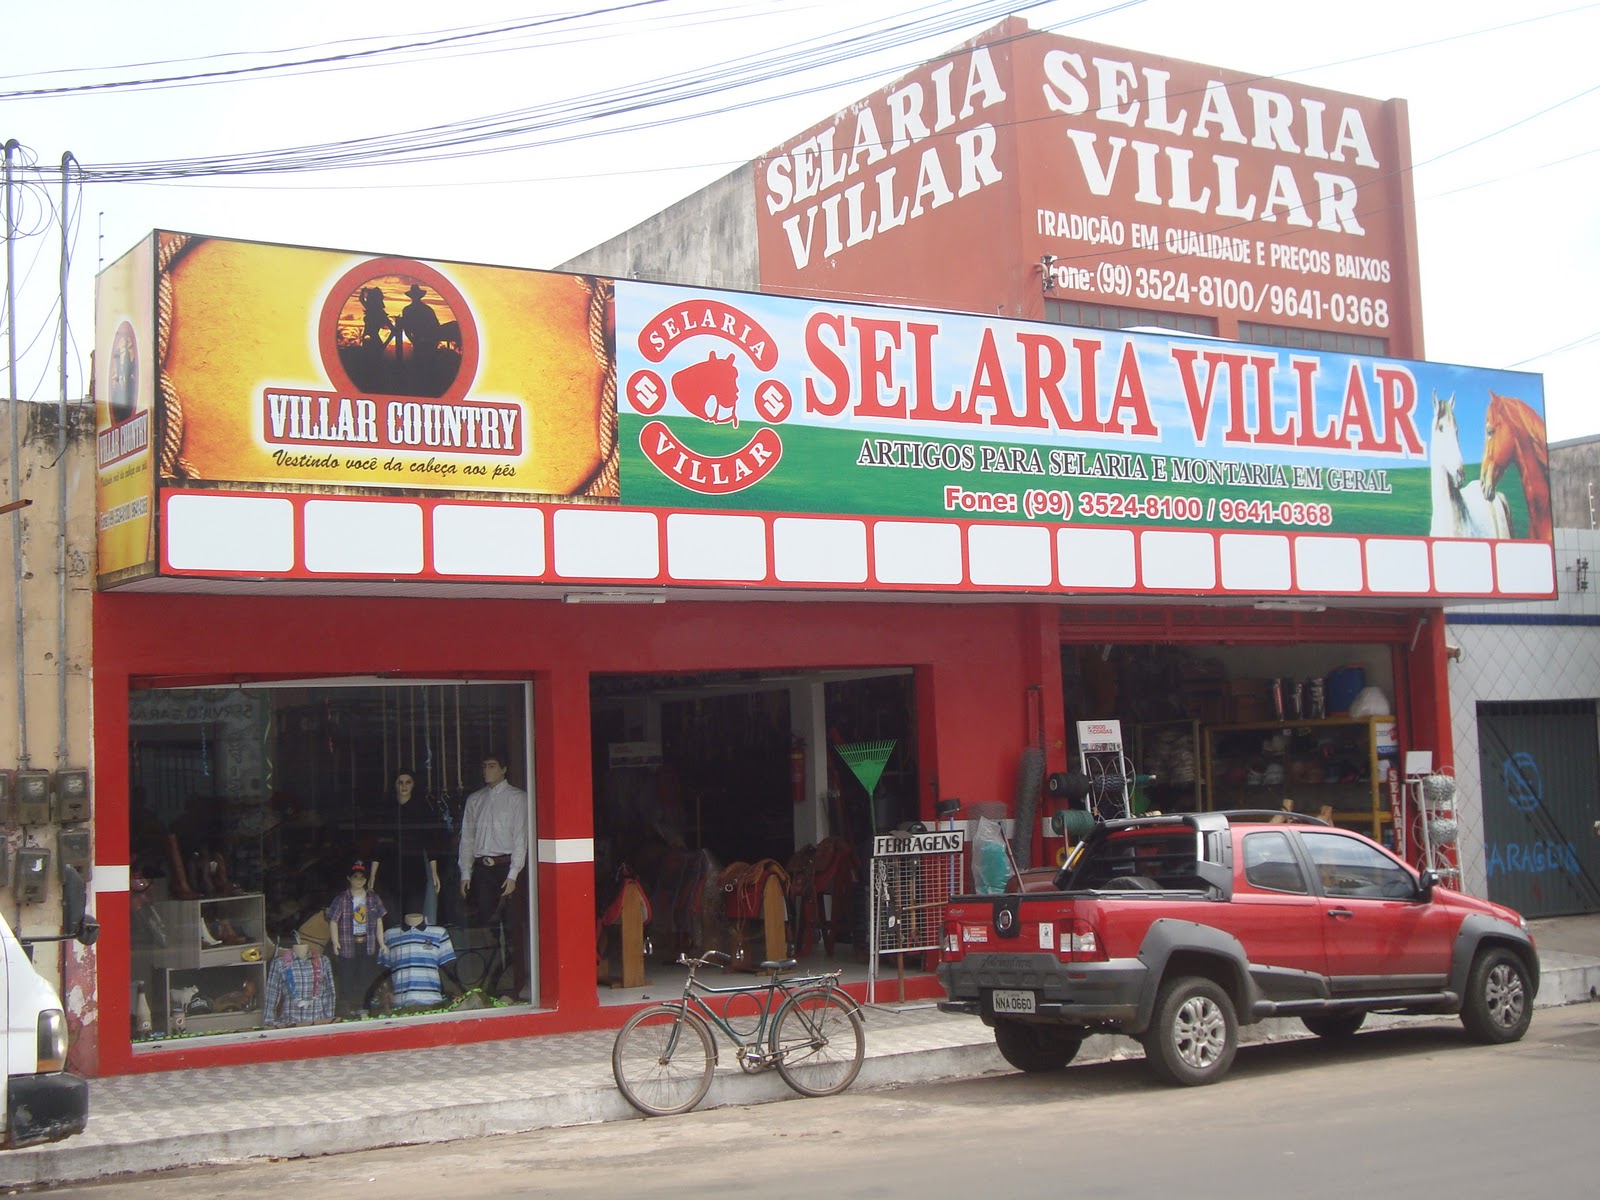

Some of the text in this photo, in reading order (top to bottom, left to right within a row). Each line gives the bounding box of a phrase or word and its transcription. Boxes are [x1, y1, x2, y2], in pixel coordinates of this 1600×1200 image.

[766, 46, 1006, 215] SELARIA
[1043, 50, 1380, 169] SELARIA
[783, 122, 1004, 270] VILLAR
[1067, 129, 1365, 236] VILLAR
[1037, 209, 1391, 283] TRADIÇÃO EM QUALIDADE E PREÇOS BAIXOS
[650, 309, 766, 361] SELARIA
[805, 311, 1425, 455] SELARIA VILLAR
[267, 394, 518, 450] VILLAR COUNTRY
[272, 449, 516, 480] Vestindo você da cabeça aos pés
[657, 431, 772, 484] VILLAR
[858, 439, 1393, 494] ARTIGOS PARA SELARIA E MONTARIA EM GERAL
[945, 487, 1333, 526] Fone: (99) 3524-8100 / 9641-0368
[877, 835, 960, 854] FERRAGENS
